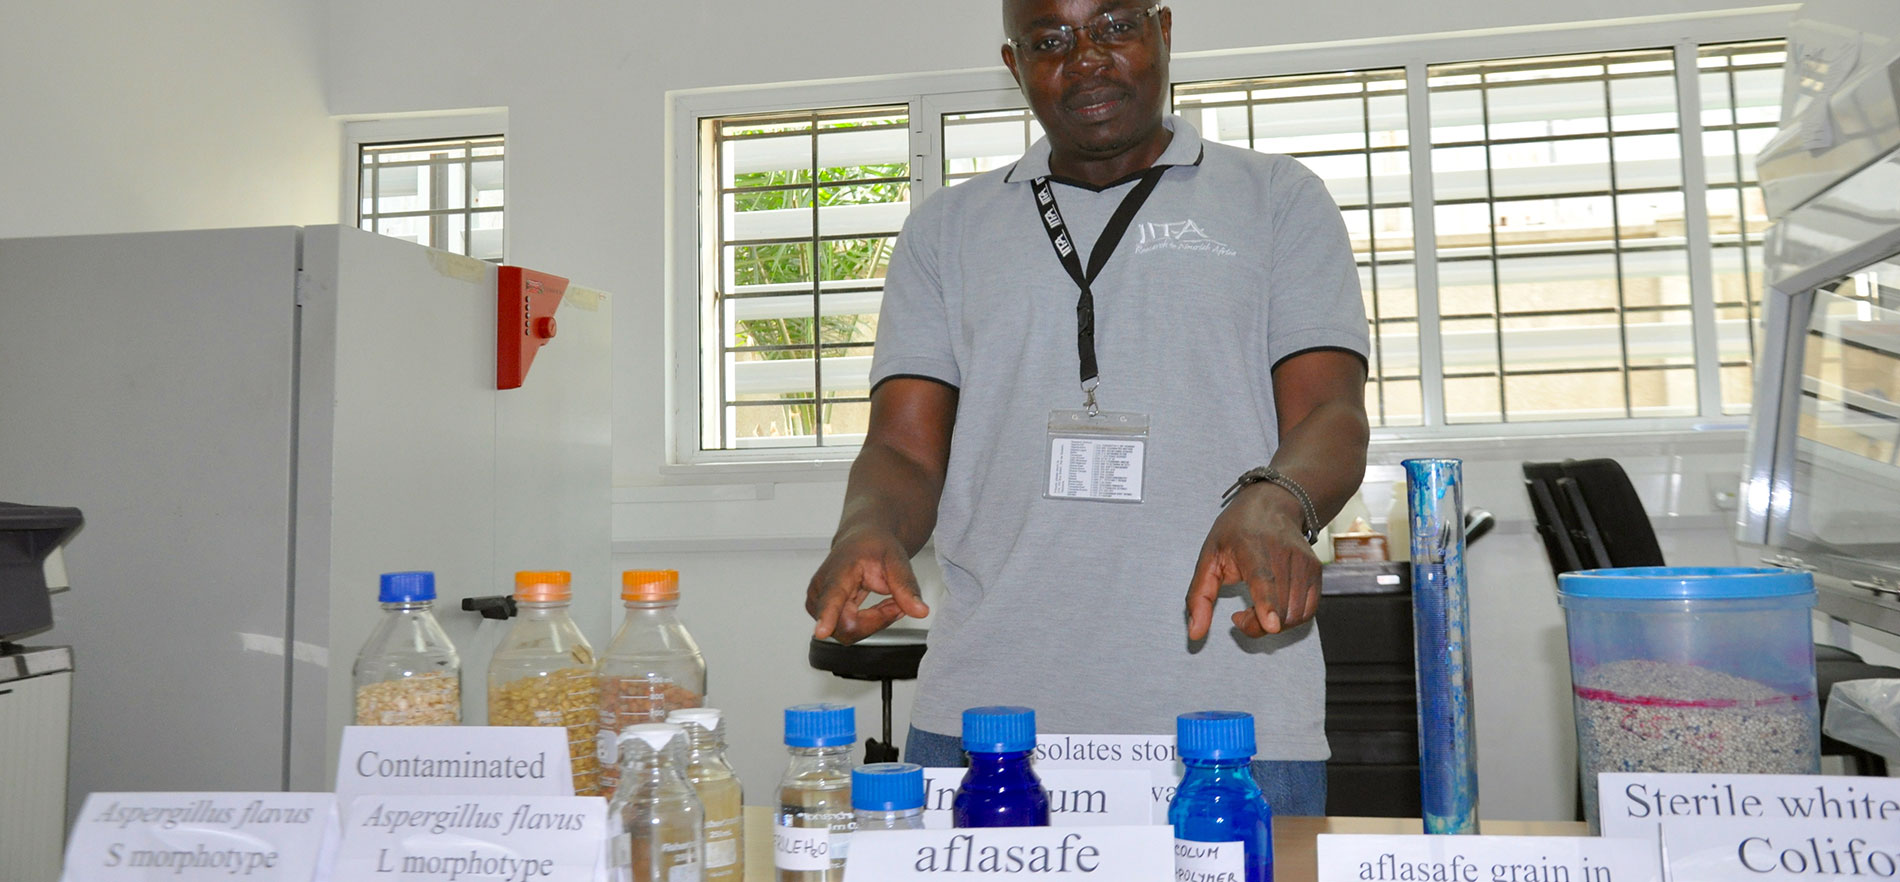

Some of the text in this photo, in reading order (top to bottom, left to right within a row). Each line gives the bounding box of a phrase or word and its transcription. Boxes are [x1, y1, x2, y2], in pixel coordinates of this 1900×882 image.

[357, 751, 546, 779] Contaminated
[1036, 737, 1179, 761] solates stor
[93, 801, 314, 829] Aspergillus flavus
[1625, 783, 1900, 820] Sterile white
[362, 803, 586, 836] Aspergillus flavus
[104, 843, 278, 875] S morphotype
[376, 848, 553, 882] L morphotype
[915, 833, 1100, 873] aflasafe
[1175, 844, 1219, 859] COLUM
[1359, 853, 1612, 882] aflasafe grain in
[1738, 837, 1900, 878] Colifo
